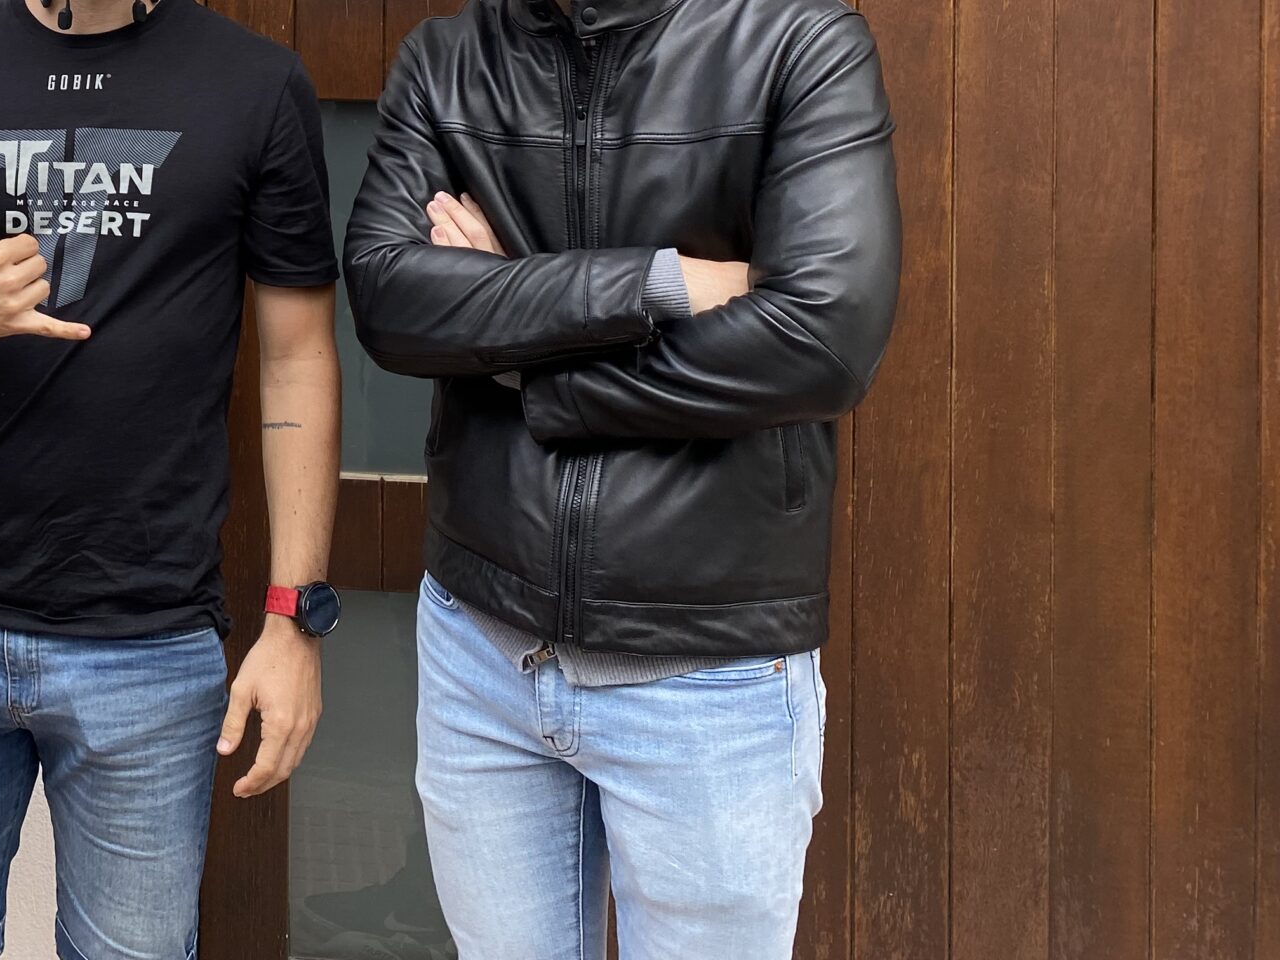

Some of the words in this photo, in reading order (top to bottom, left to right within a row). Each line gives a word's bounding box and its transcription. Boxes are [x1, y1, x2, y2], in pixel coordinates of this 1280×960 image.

[16, 199, 44, 207] MTB
[104, 199, 140, 208] RACE
[5, 210, 151, 237] DESERT
